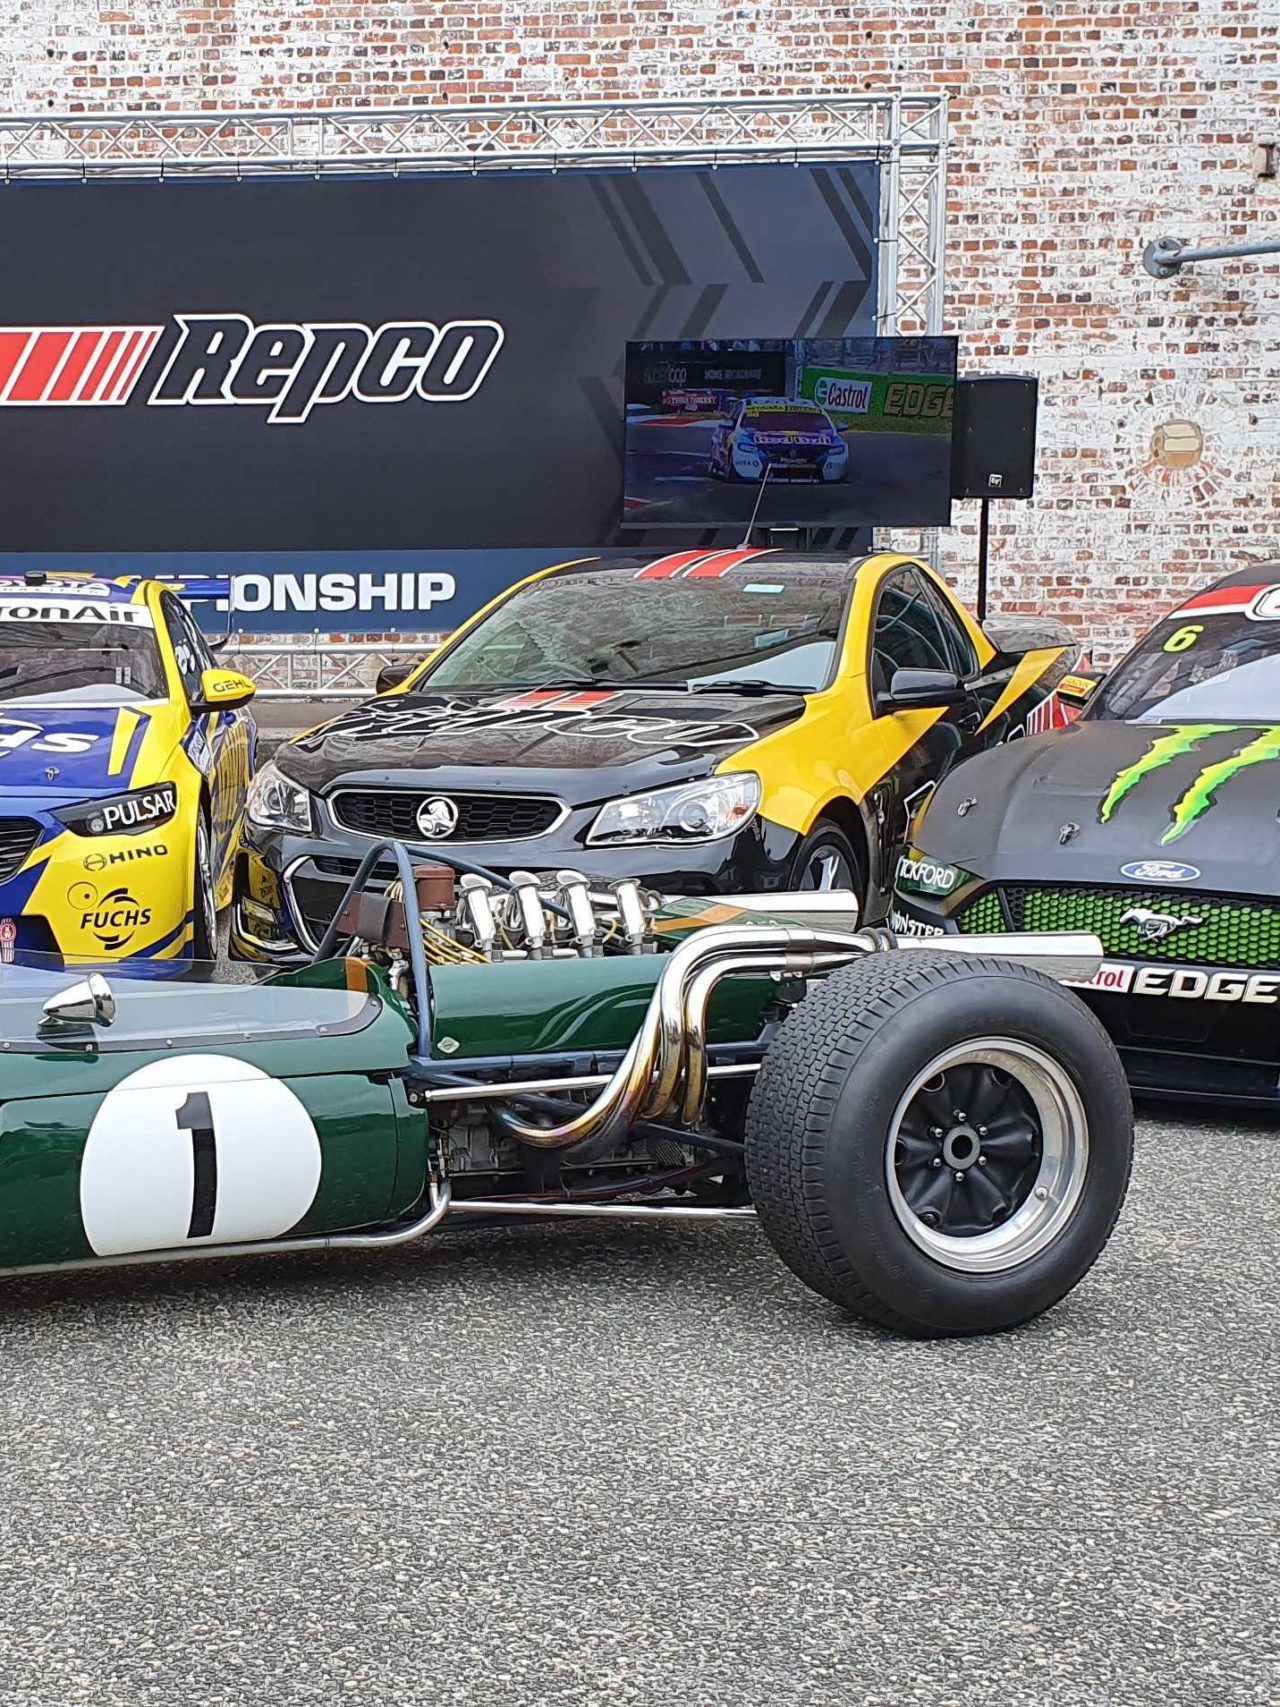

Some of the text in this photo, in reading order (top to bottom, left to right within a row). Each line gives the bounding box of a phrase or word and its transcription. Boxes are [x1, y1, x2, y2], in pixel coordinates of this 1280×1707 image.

[147, 314, 505, 424] Repco
[828, 383, 869, 409] Castrol
[1163, 625, 1204, 652] 6
[213, 679, 251, 693] GEHL
[103, 790, 176, 829] PULSAR
[109, 844, 168, 864] HINO
[1132, 862, 1191, 881] Ford
[80, 909, 151, 930] FUCHS
[1132, 967, 1279, 1004] EDGE
[175, 1091, 218, 1239] 1
